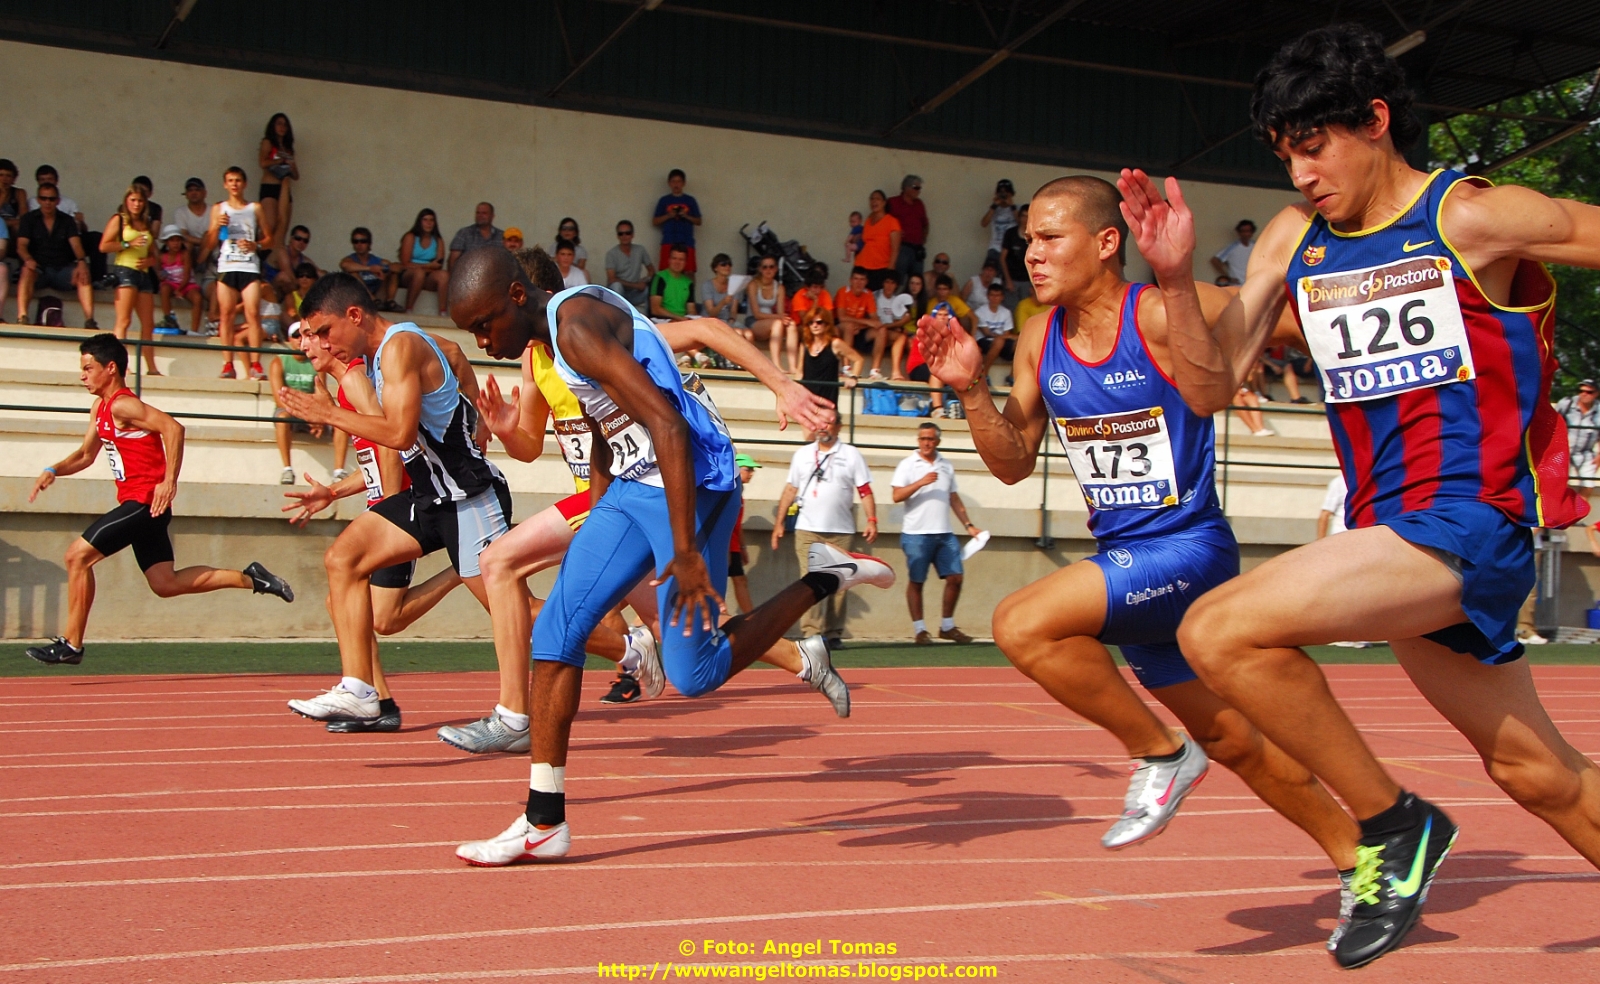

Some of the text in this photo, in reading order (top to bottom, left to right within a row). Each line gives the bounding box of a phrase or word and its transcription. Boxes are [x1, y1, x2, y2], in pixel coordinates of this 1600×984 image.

[1310, 268, 1440, 303] Divina Pastora
[1330, 299, 1435, 360] 126
[1103, 369, 1146, 385] ADAL
[1066, 417, 1157, 438] Divina Pastora
[571, 437, 584, 460] 3
[1085, 442, 1151, 480] 173
